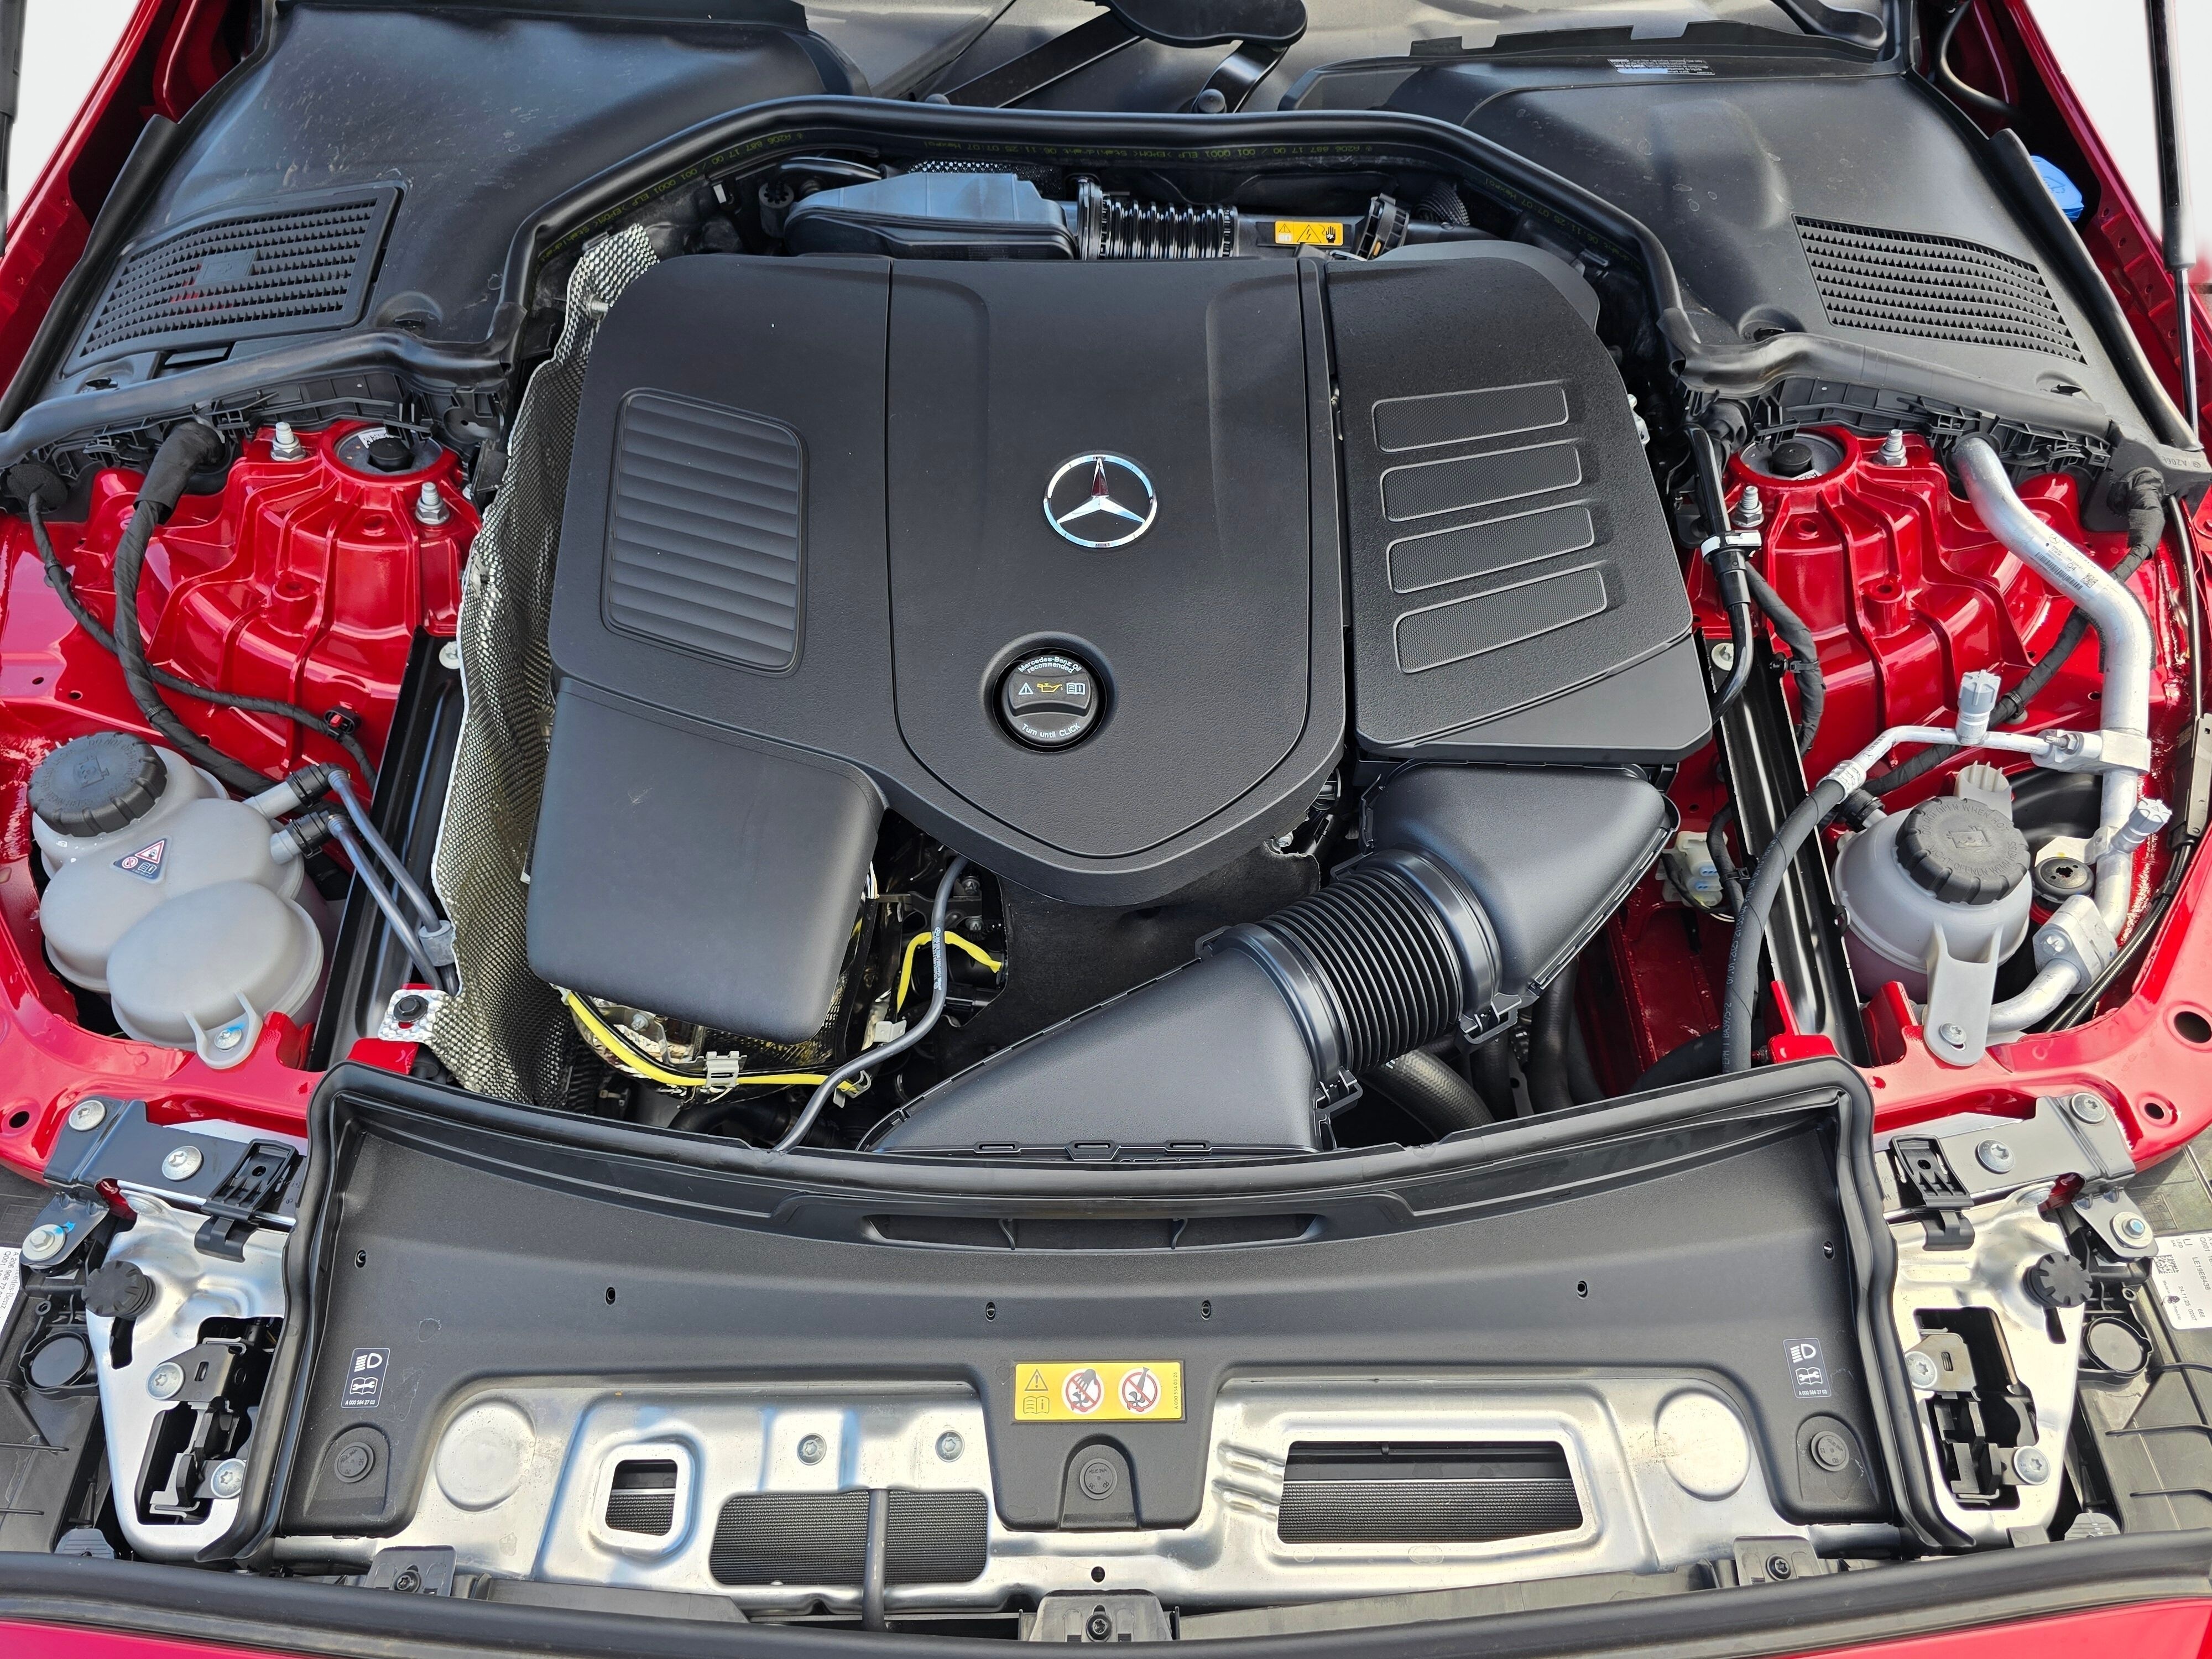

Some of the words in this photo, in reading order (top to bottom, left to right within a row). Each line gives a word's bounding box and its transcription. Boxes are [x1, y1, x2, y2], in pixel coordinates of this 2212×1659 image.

[728, 147, 740, 159] 17
[1018, 656, 1072, 672] Mercedes-Benz
[1026, 661, 1074, 674] recommended
[1021, 723, 1038, 737] Turn
[1040, 731, 1057, 739] until
[1058, 722, 1082, 737] CLICK
[8, 1257, 17, 1269] 206
[3, 1270, 12, 1281] 906
